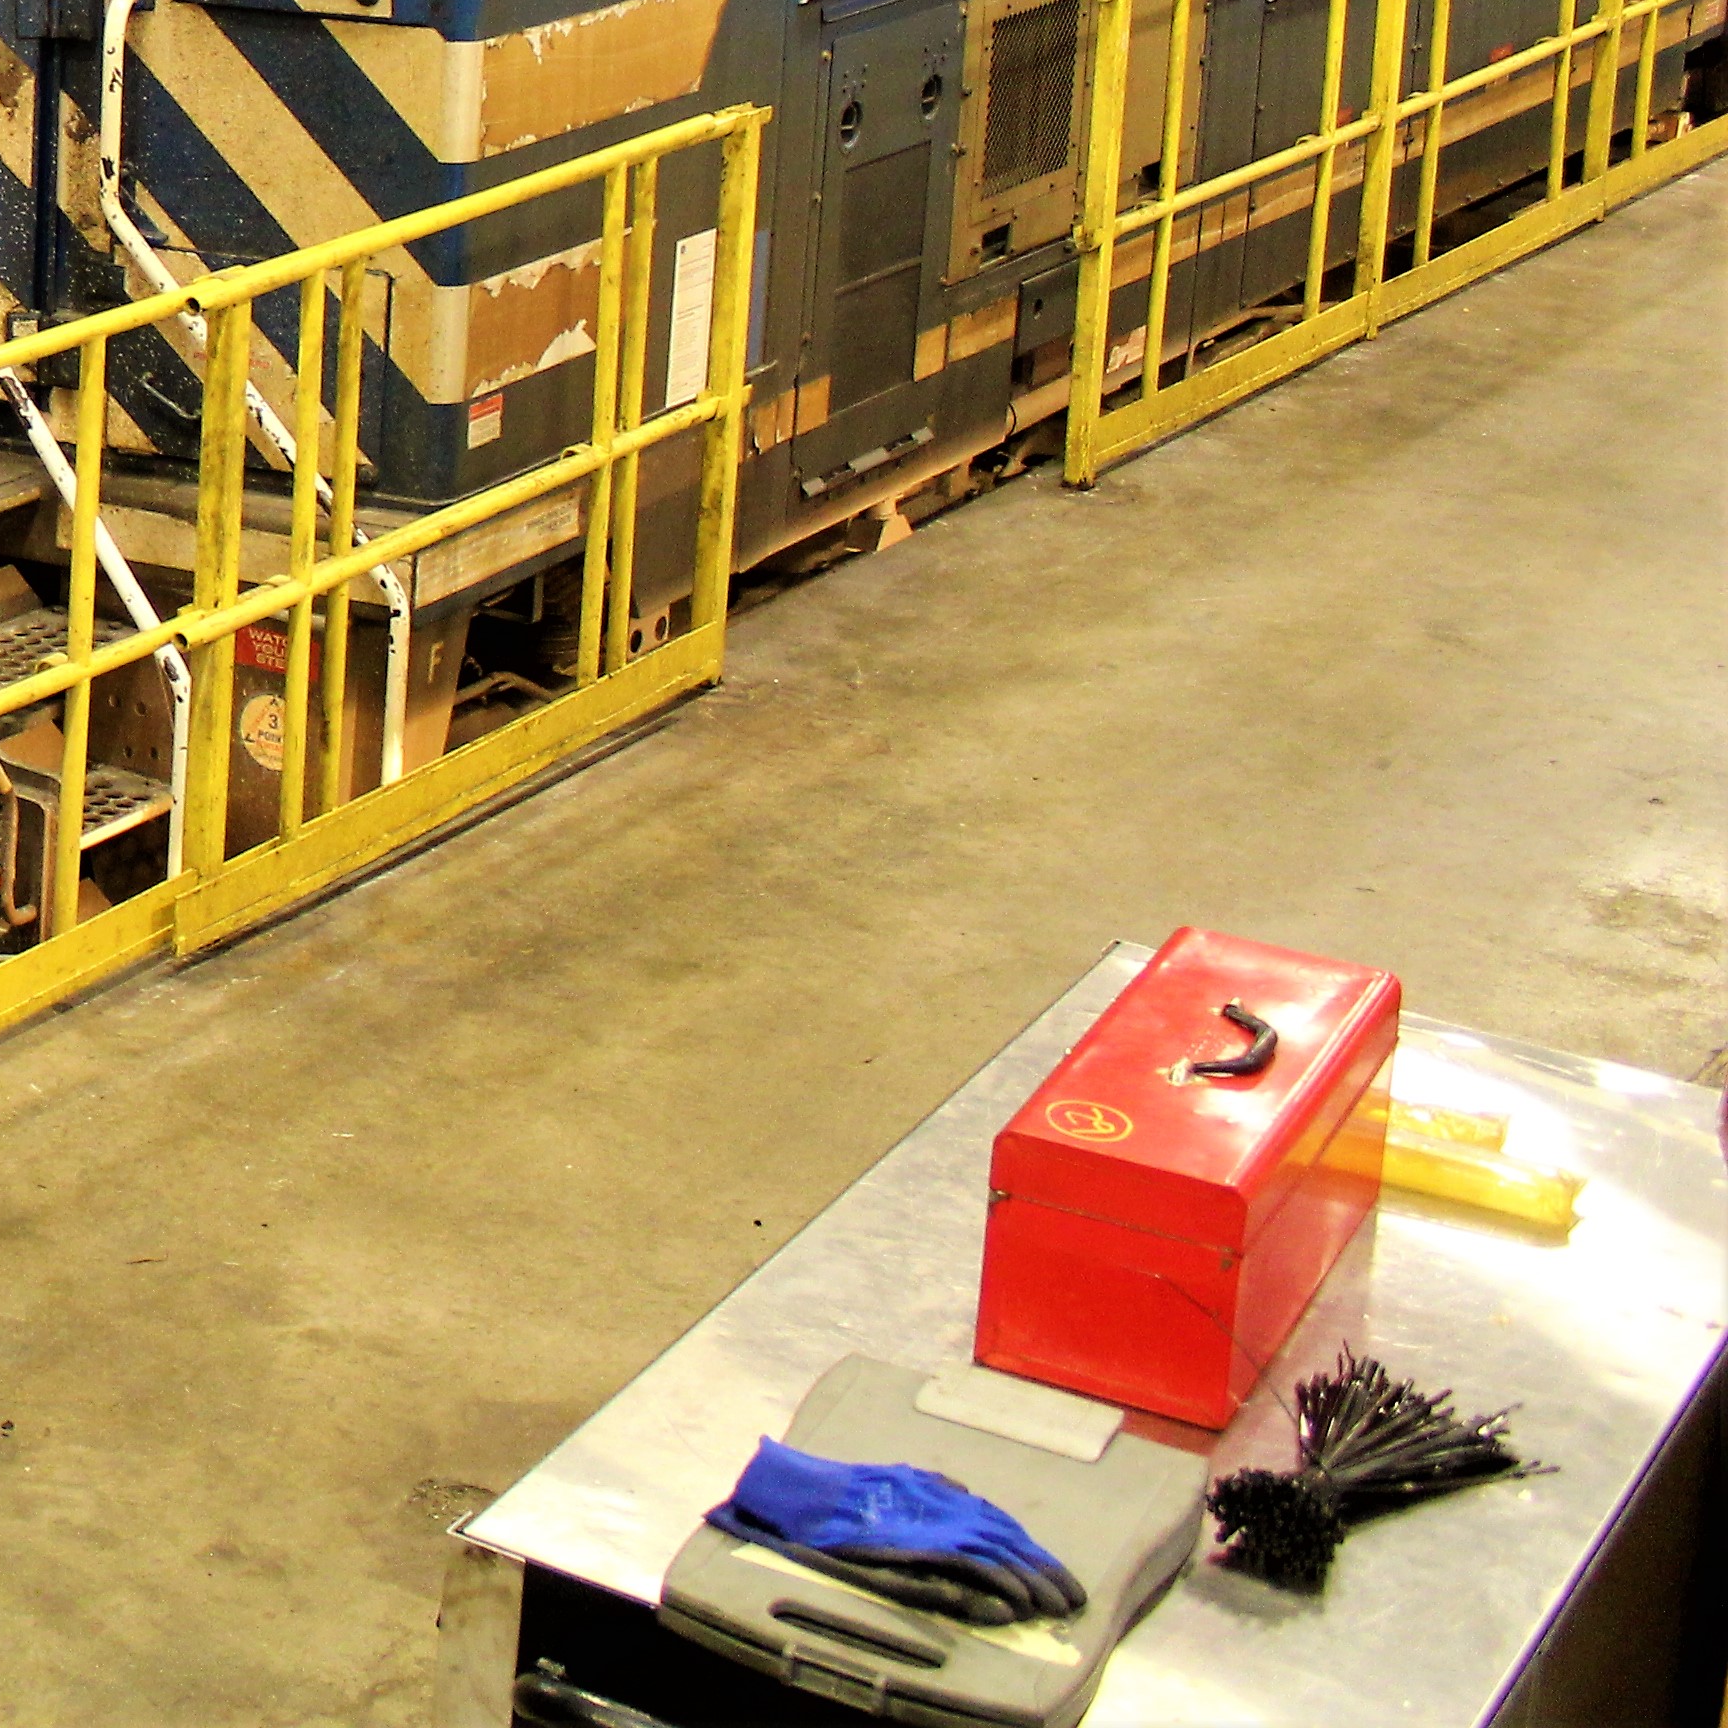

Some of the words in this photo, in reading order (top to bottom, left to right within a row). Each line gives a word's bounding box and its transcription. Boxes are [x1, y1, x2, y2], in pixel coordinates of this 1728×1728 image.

[249, 627, 286, 648] WATC
[253, 640, 285, 657] YOU
[256, 652, 286, 669] STE
[427, 641, 443, 683] F
[269, 714, 278, 729] 3
